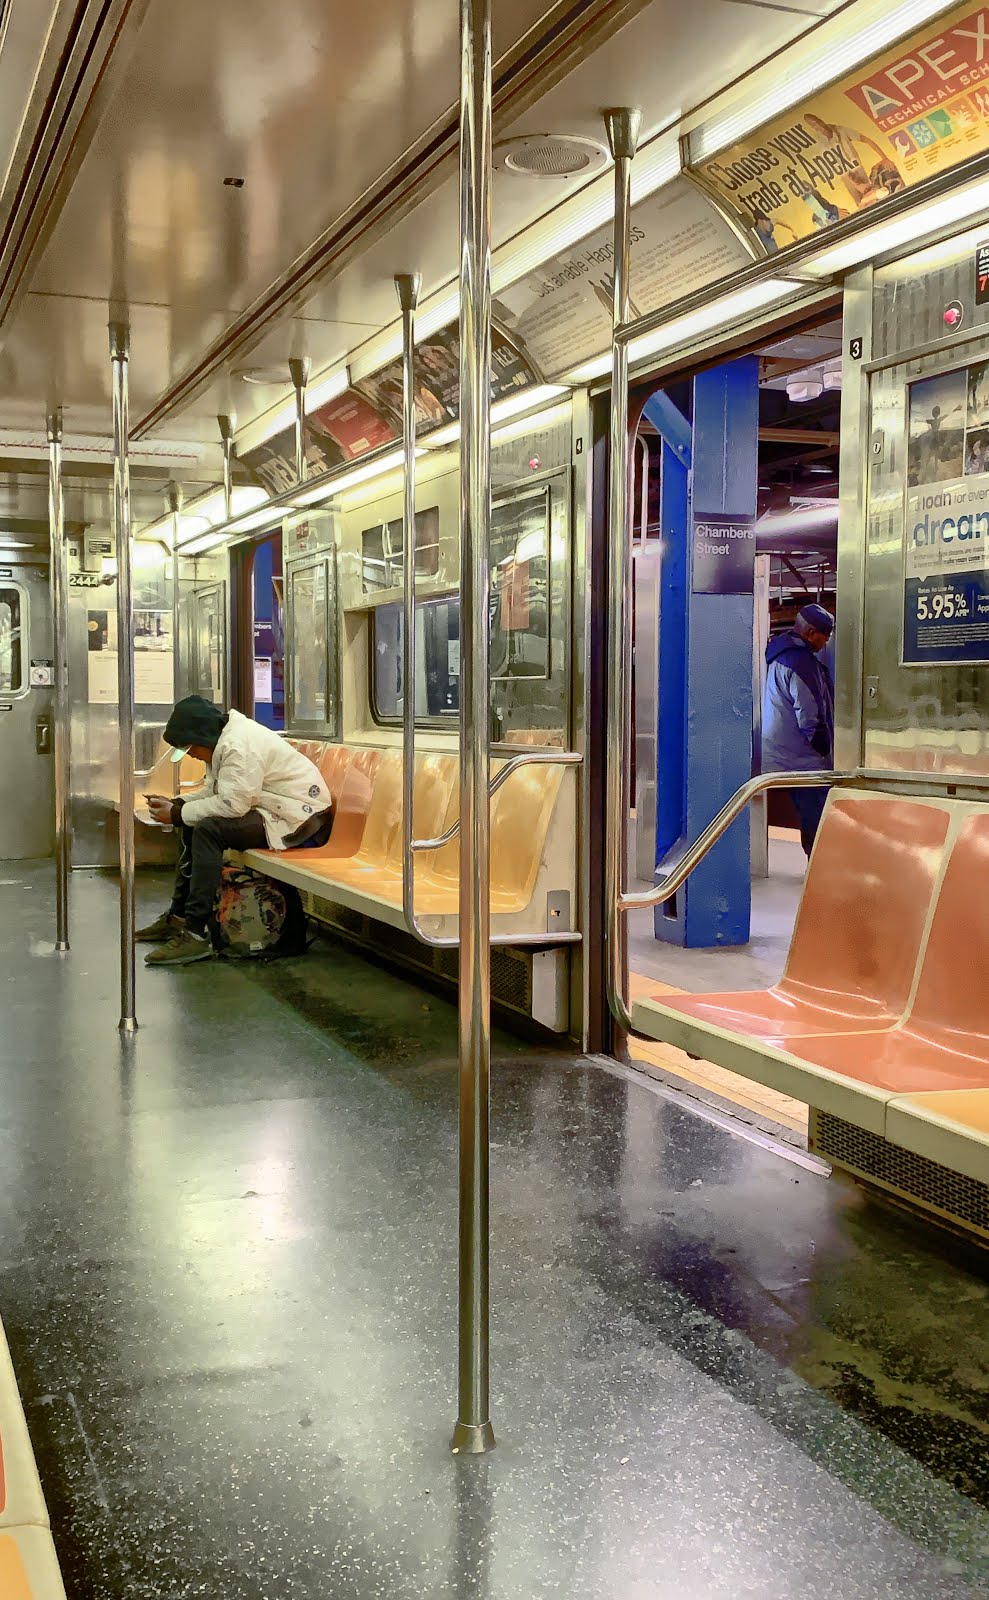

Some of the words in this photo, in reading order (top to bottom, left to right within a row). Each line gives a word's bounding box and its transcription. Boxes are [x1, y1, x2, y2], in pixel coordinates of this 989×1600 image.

[861, 13, 989, 120] APEX
[878, 84, 956, 129] TECHNICAL
[706, 147, 780, 191] Choose
[767, 123, 818, 166] your
[737, 177, 789, 214] trade
[781, 165, 811, 198] at
[796, 144, 860, 191] Apex.
[528, 260, 590, 298] Sustainable
[581, 226, 646, 267] Happss
[852, 341, 860, 358] 3
[922, 492, 952, 510] loan
[954, 492, 966, 504] for
[695, 525, 754, 539] Chambers
[696, 542, 730, 555] Street
[70, 576, 98, 586] 2444
